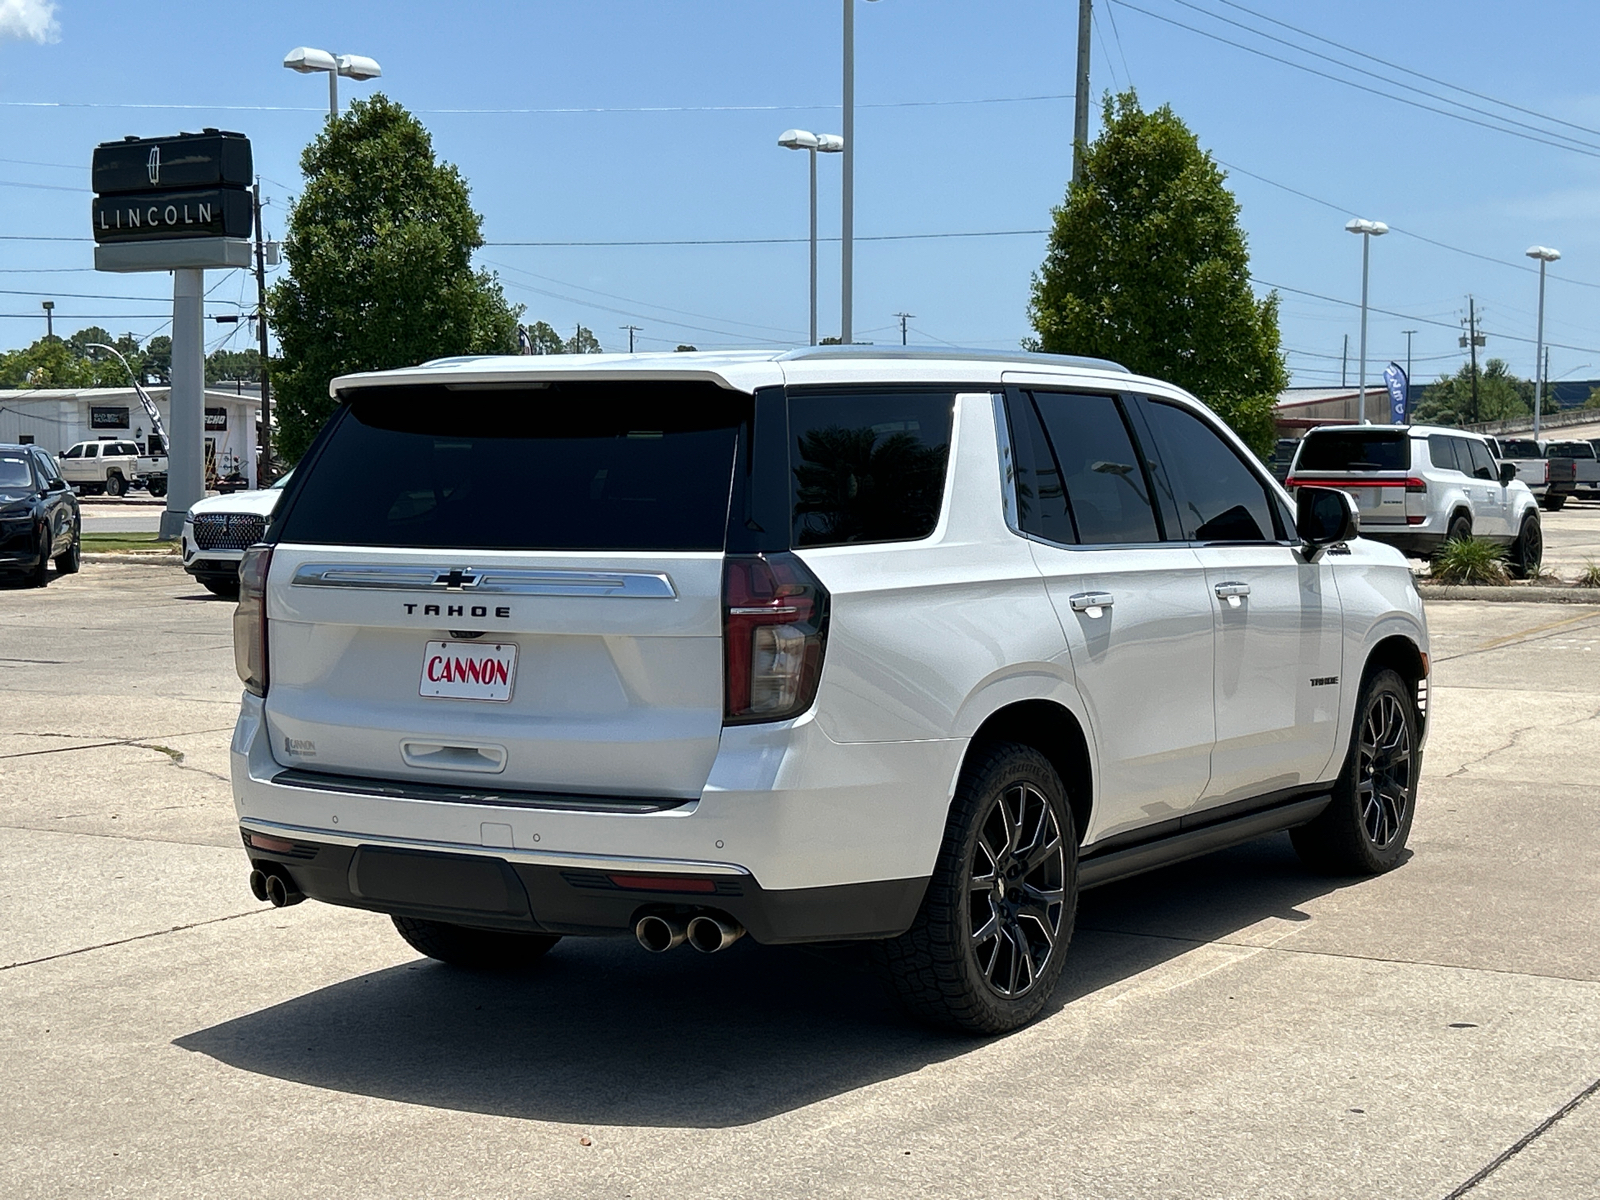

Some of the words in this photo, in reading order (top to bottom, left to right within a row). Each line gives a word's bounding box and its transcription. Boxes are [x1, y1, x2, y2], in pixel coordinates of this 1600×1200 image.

[100, 202, 212, 230] LINCOLN
[402, 602, 511, 619] TAHOE
[426, 655, 510, 687] CANNON
